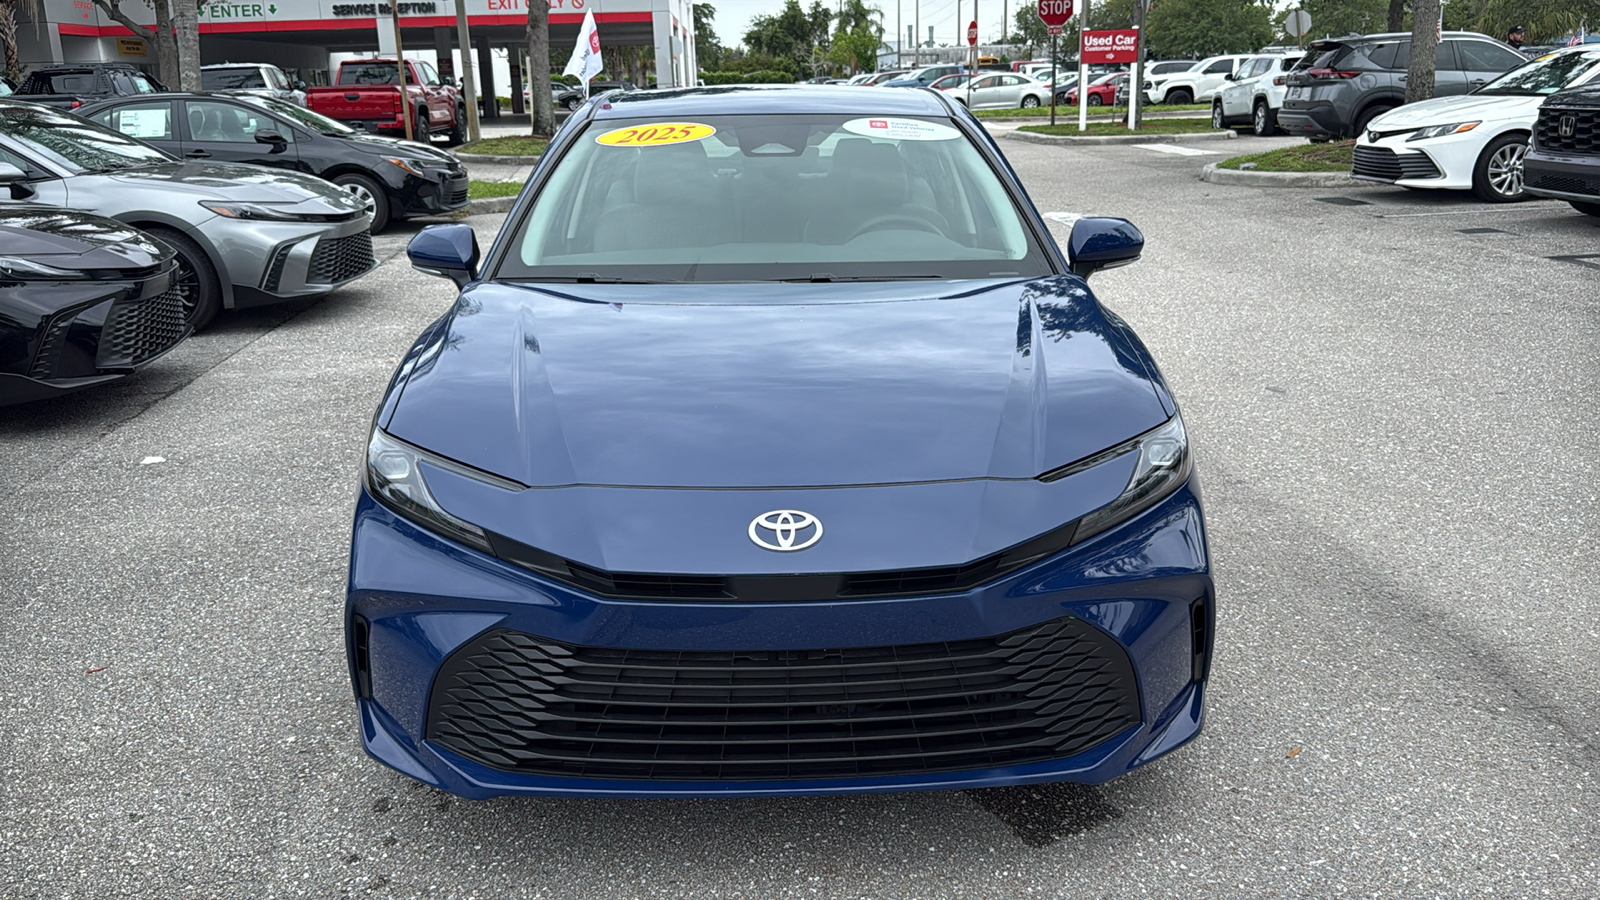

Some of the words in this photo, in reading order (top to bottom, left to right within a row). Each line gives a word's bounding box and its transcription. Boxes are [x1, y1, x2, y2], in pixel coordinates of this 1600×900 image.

[73, 1, 94, 11] SERVICE
[210, 4, 263, 18] ENTER
[332, 4, 376, 16] SERVICE
[378, 2, 436, 15] REEPTION
[1040, 0, 1072, 15] STOP
[1084, 34, 1113, 46] Used
[1115, 34, 1136, 45] Car
[614, 126, 697, 144] 2025
